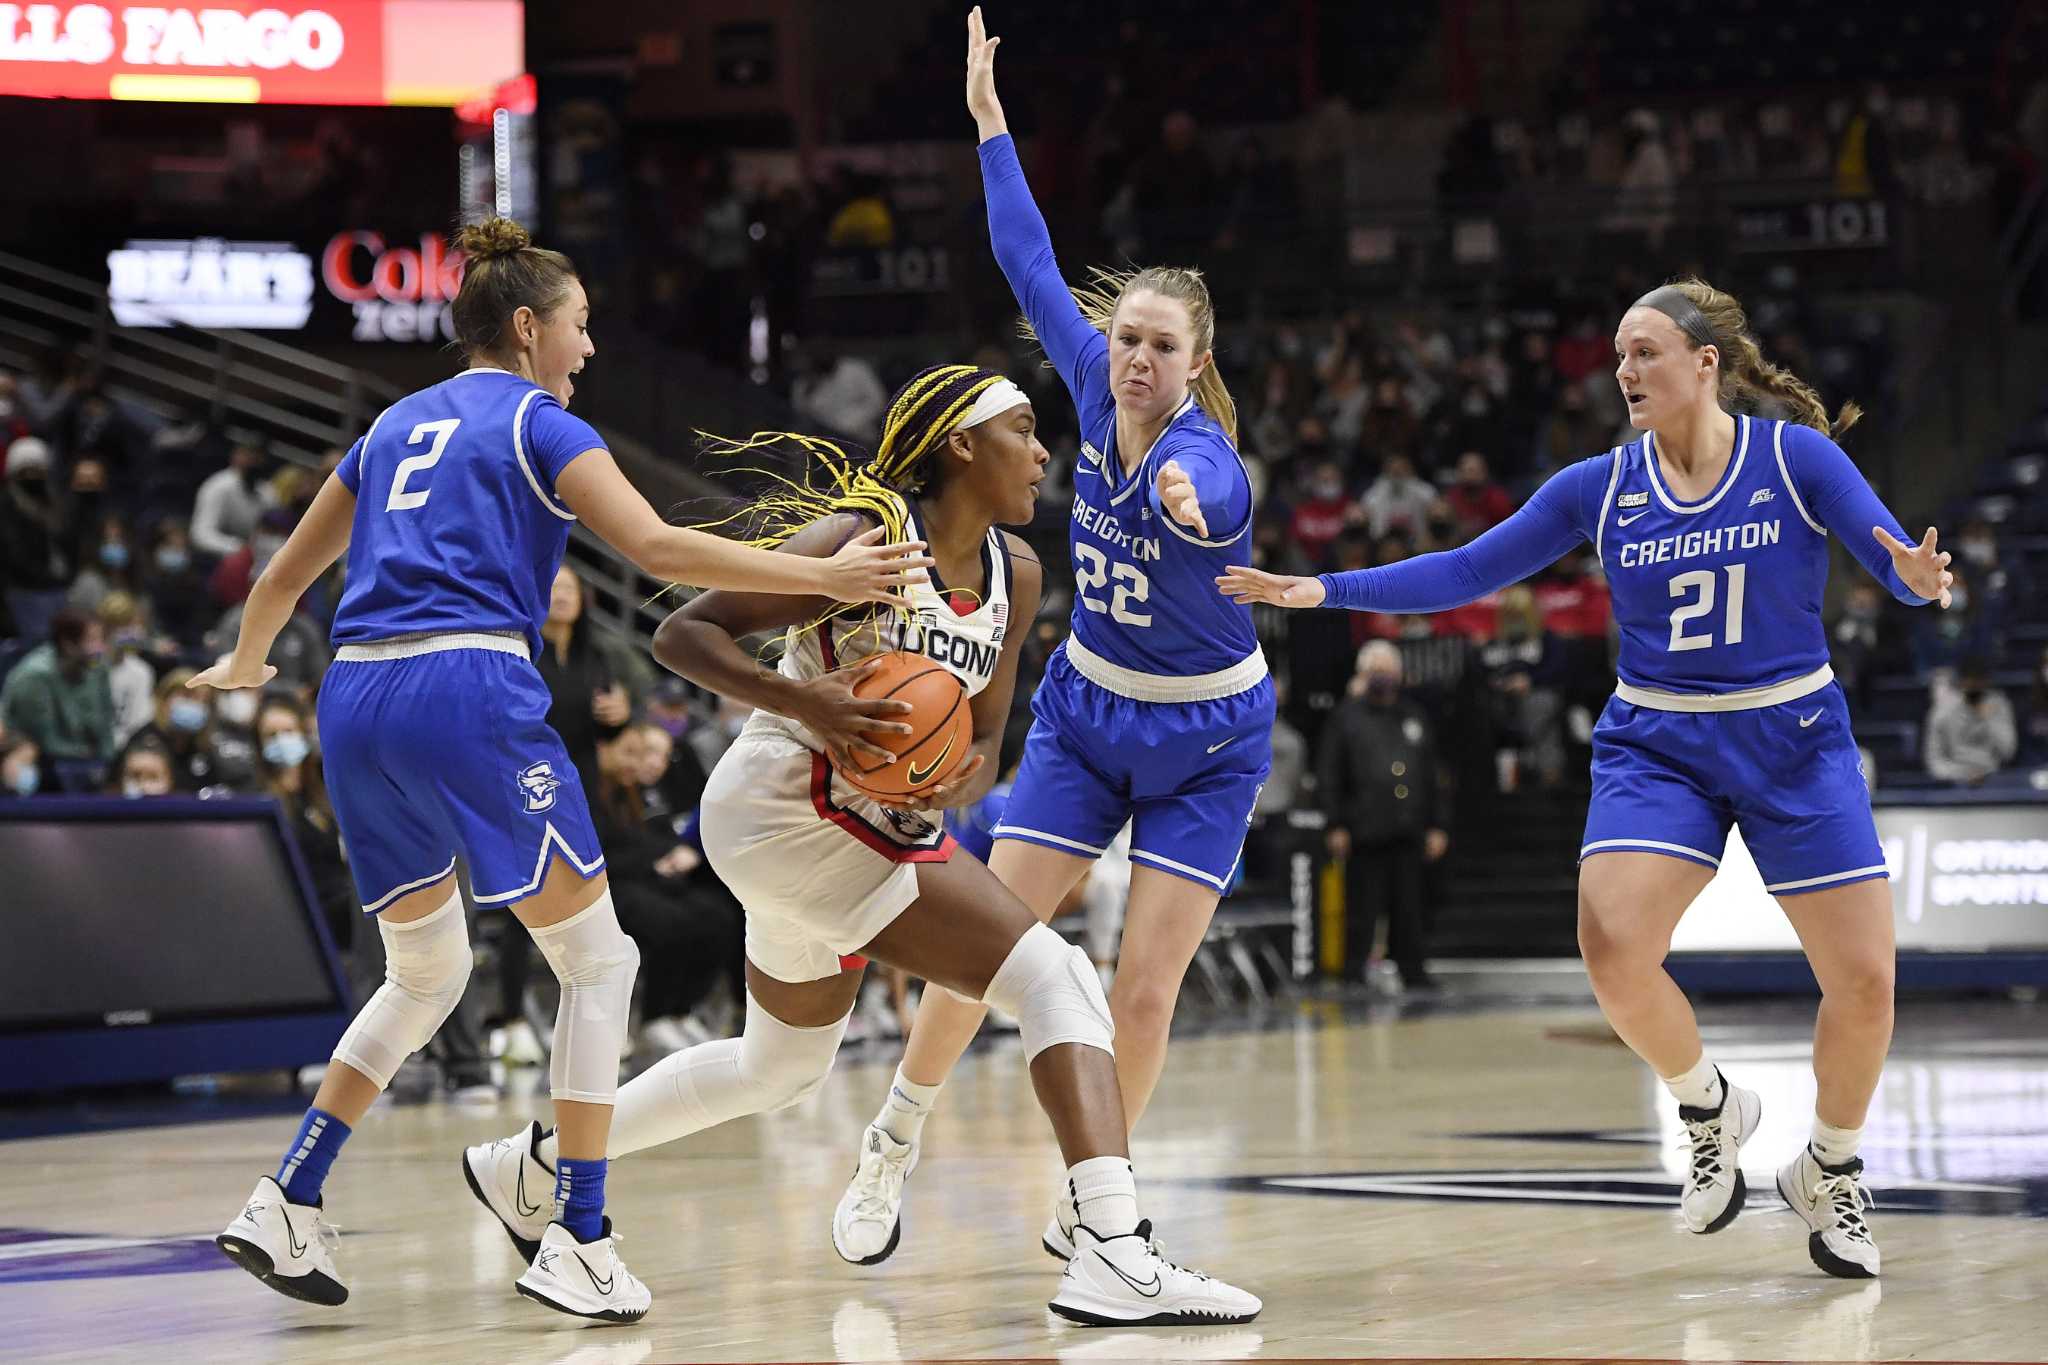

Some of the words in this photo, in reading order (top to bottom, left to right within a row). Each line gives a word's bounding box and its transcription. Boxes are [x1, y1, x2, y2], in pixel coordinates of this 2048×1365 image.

[122, 7, 344, 69] FARGO
[322, 230, 465, 303] Cok
[385, 419, 461, 512] 2
[1620, 519, 1781, 568] CREIGHTON
[1076, 541, 1152, 627] 22
[1668, 563, 1746, 652] 21
